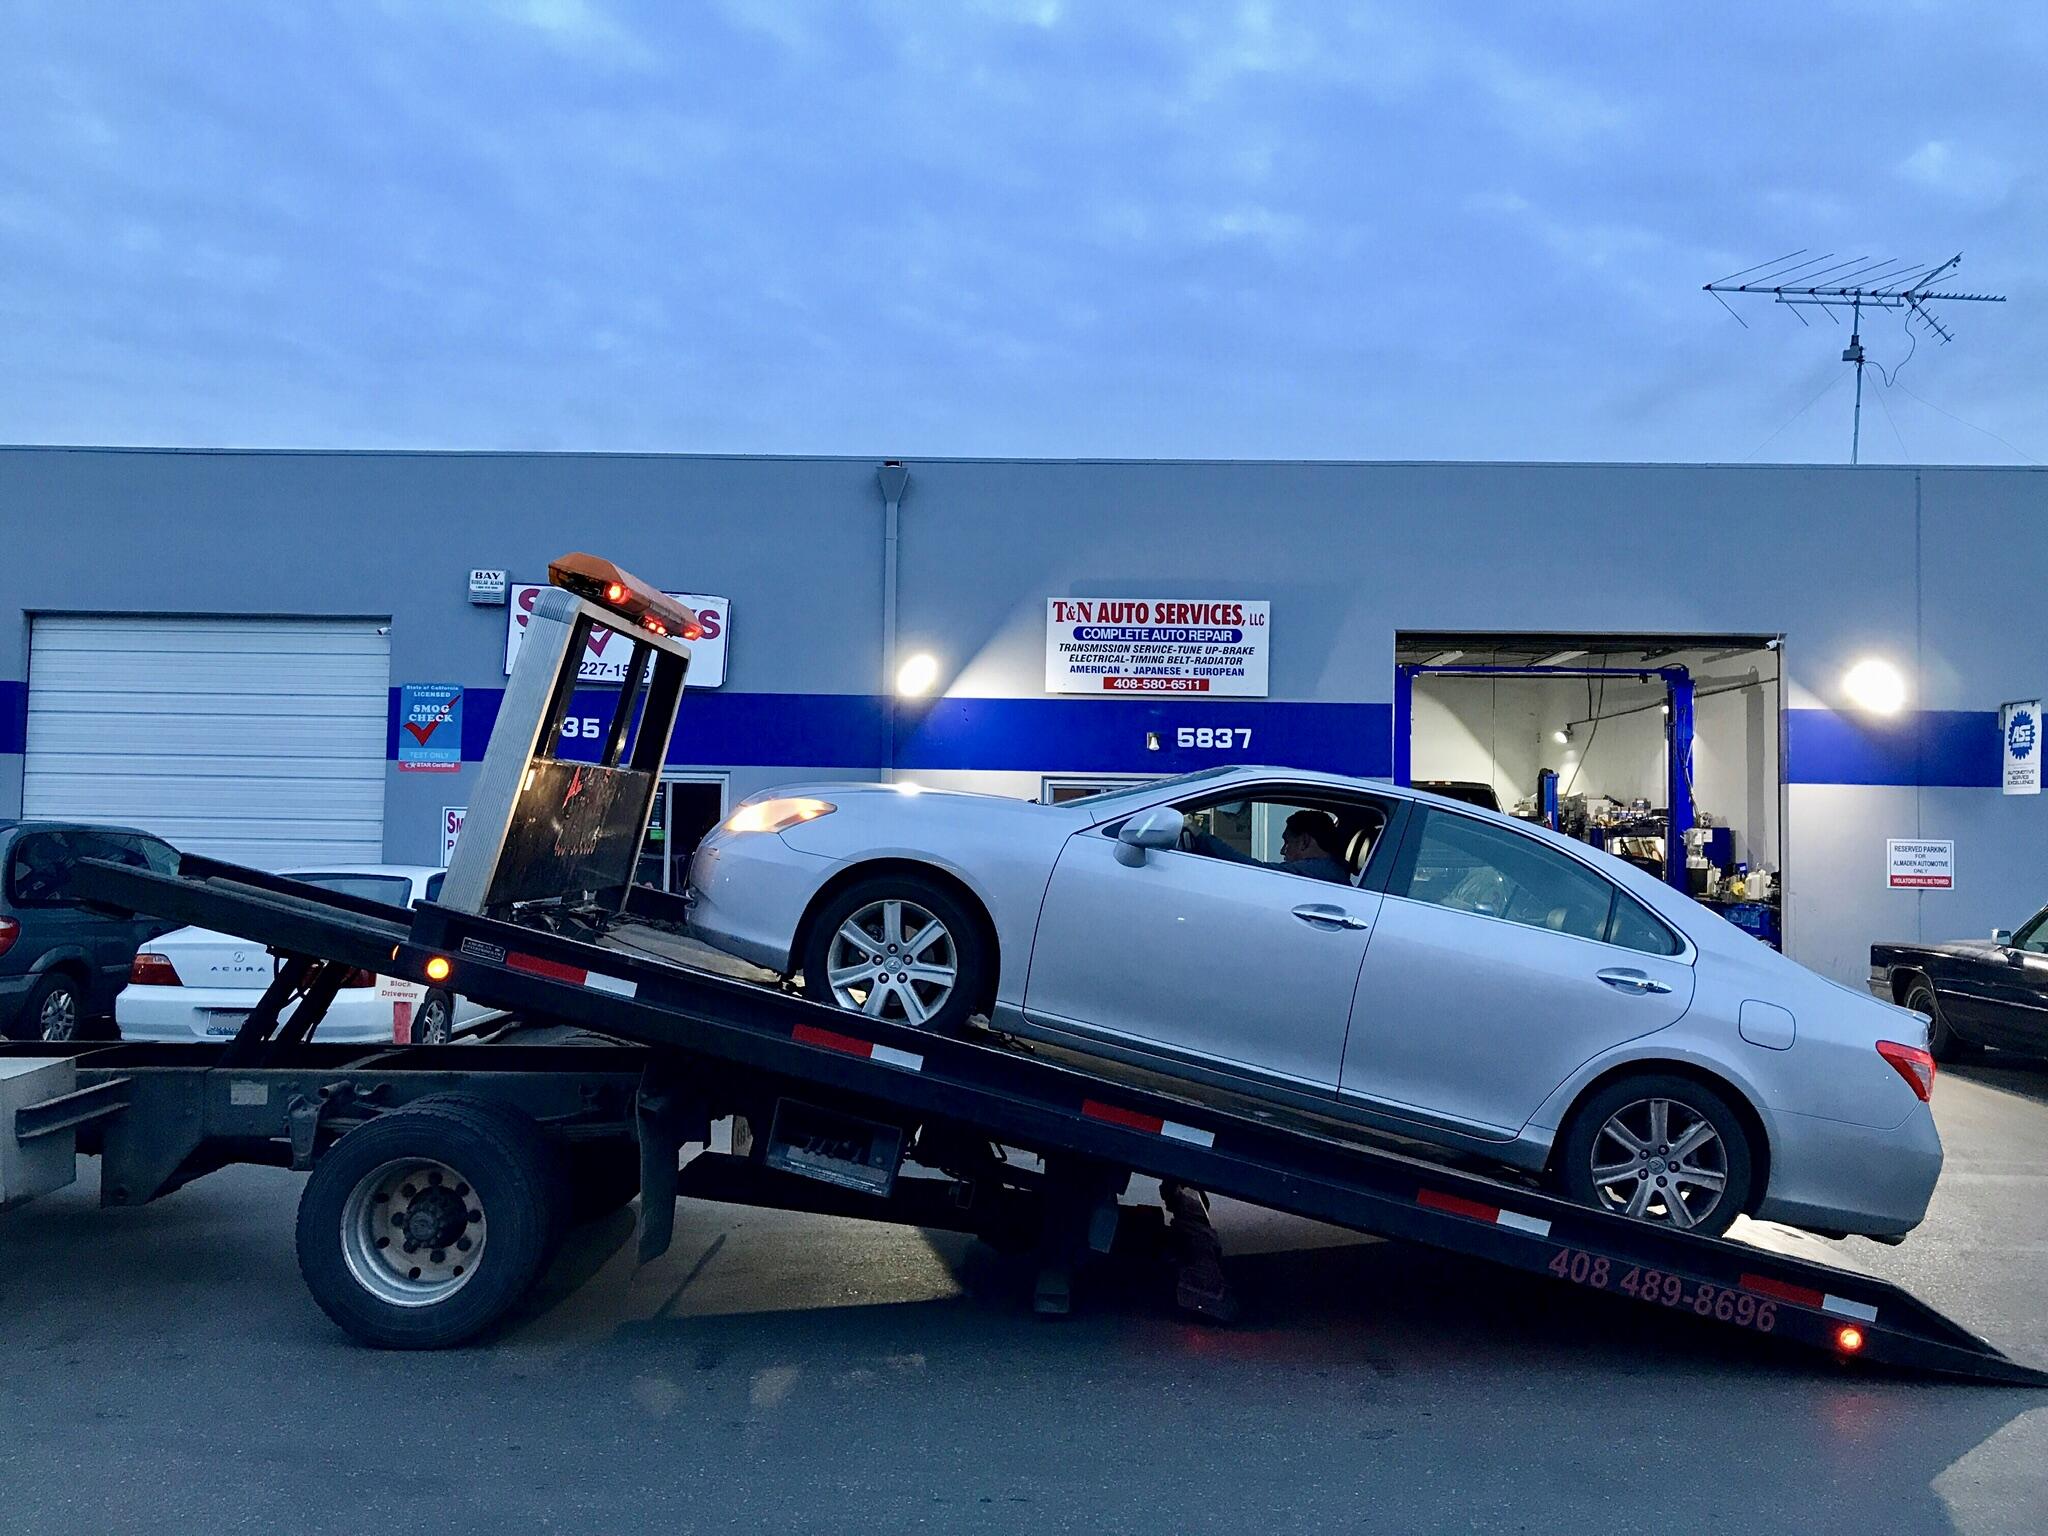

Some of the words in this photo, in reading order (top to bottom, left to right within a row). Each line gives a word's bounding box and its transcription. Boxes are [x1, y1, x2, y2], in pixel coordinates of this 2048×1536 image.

[475, 571, 501, 580] BAY
[1052, 601, 1093, 623] T&N
[1097, 602, 1149, 624] AUTO
[1154, 602, 1246, 626] SERVICES,
[1249, 613, 1265, 626] LLC
[1082, 627, 1149, 640] COMPLETE
[1151, 629, 1187, 641] AUTO
[1188, 629, 1233, 642] REPAIR
[1059, 643, 1131, 653] TRANSMISSION
[1132, 644, 1203, 655] SERVICE-TUNE
[1204, 646, 1256, 656] UP-BRAKE
[1068, 654, 1165, 664] ELECTRICAL-TIMING
[1166, 656, 1244, 666] BELT-RADIATOR
[1069, 665, 1120, 674] AMERICAN
[1132, 666, 1182, 675] JAPANESE
[1193, 667, 1245, 677] EUROPEAN
[1113, 678, 1200, 690] 408-580-6511
[413, 704, 450, 713] SMOG
[408, 713, 453, 722] CHECK
[1177, 727, 1252, 749] 5837
[2011, 724, 2032, 743] ASE
[1894, 845, 1922, 853] RESERVED
[1923, 845, 1948, 854] PARKING
[390, 980, 412, 988] Block
[381, 990, 418, 999] Driveway
[1548, 1247, 1611, 1289] 408
[1620, 1265, 1779, 1333] 489-8696
